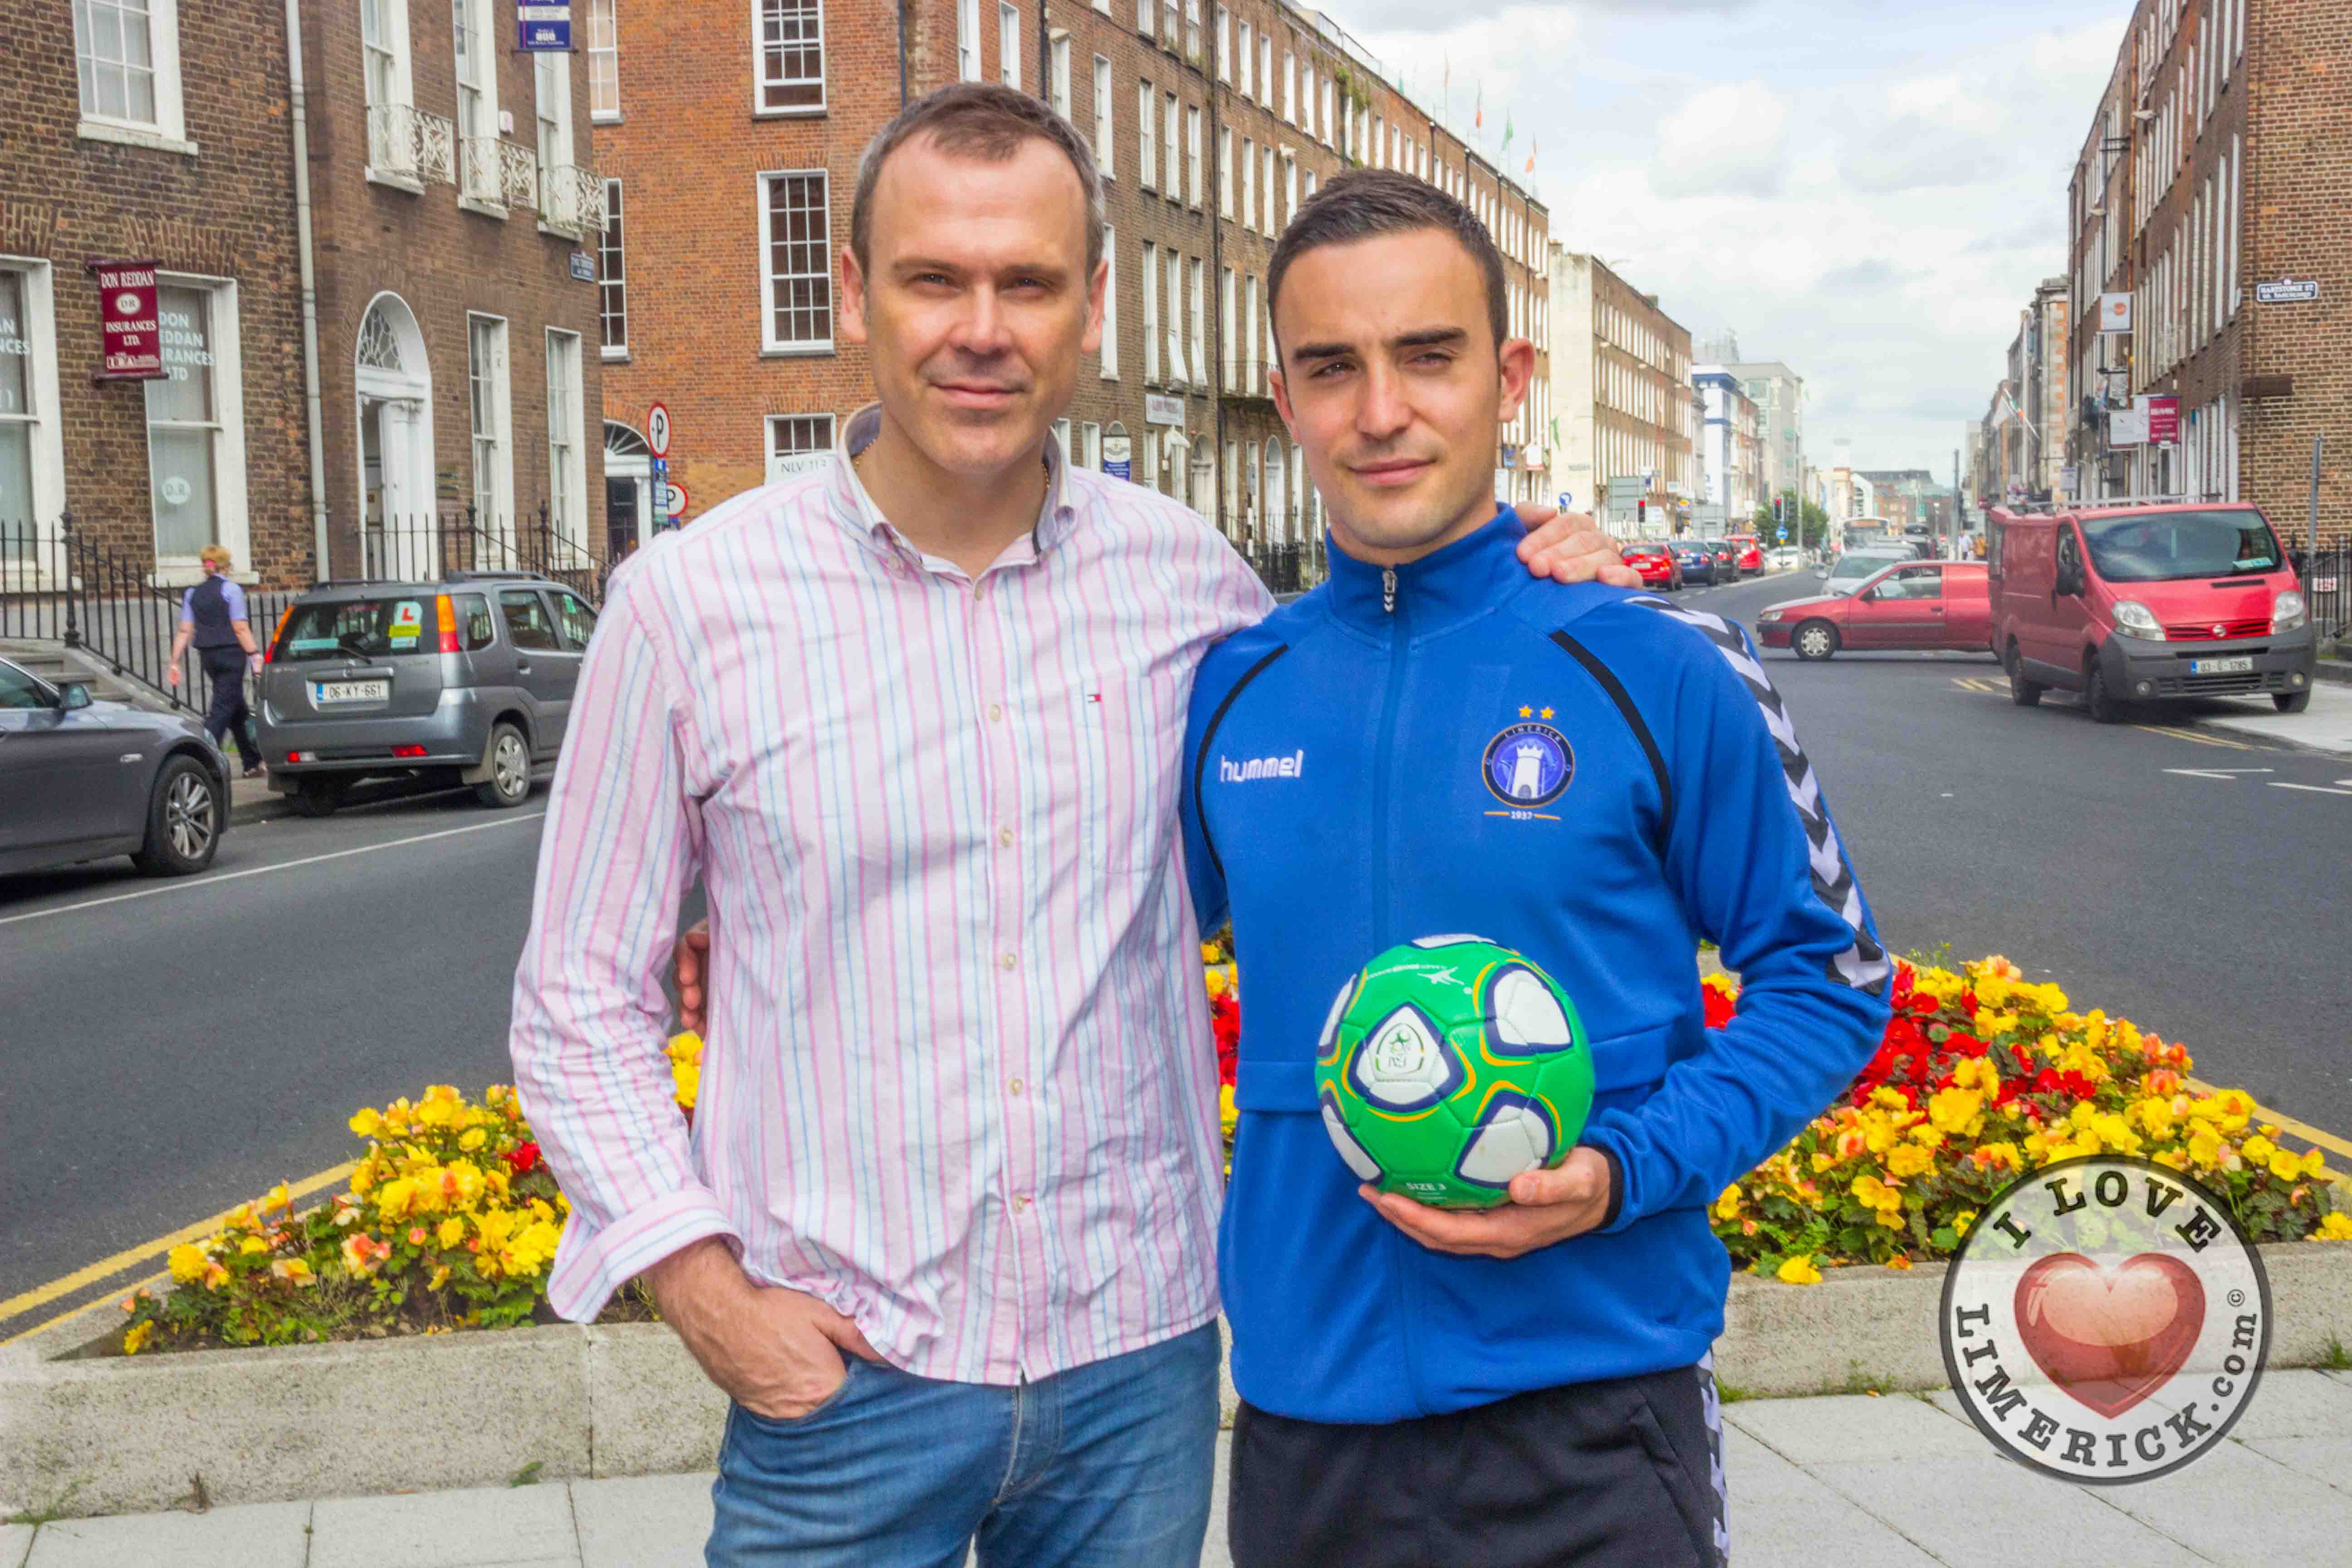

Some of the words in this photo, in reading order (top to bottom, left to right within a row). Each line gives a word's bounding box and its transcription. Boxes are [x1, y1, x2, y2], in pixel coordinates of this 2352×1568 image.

[100, 272, 118, 288] DON
[120, 270, 154, 287] REDDAN
[159, 329, 203, 348] EDDAN
[402, 607, 414, 621] L
[1504, 725, 1562, 742] LIMERICK
[1220, 749, 1304, 783] hummel
[1510, 810, 1533, 820] 1937
[1406, 1182, 1436, 1191] SIZE
